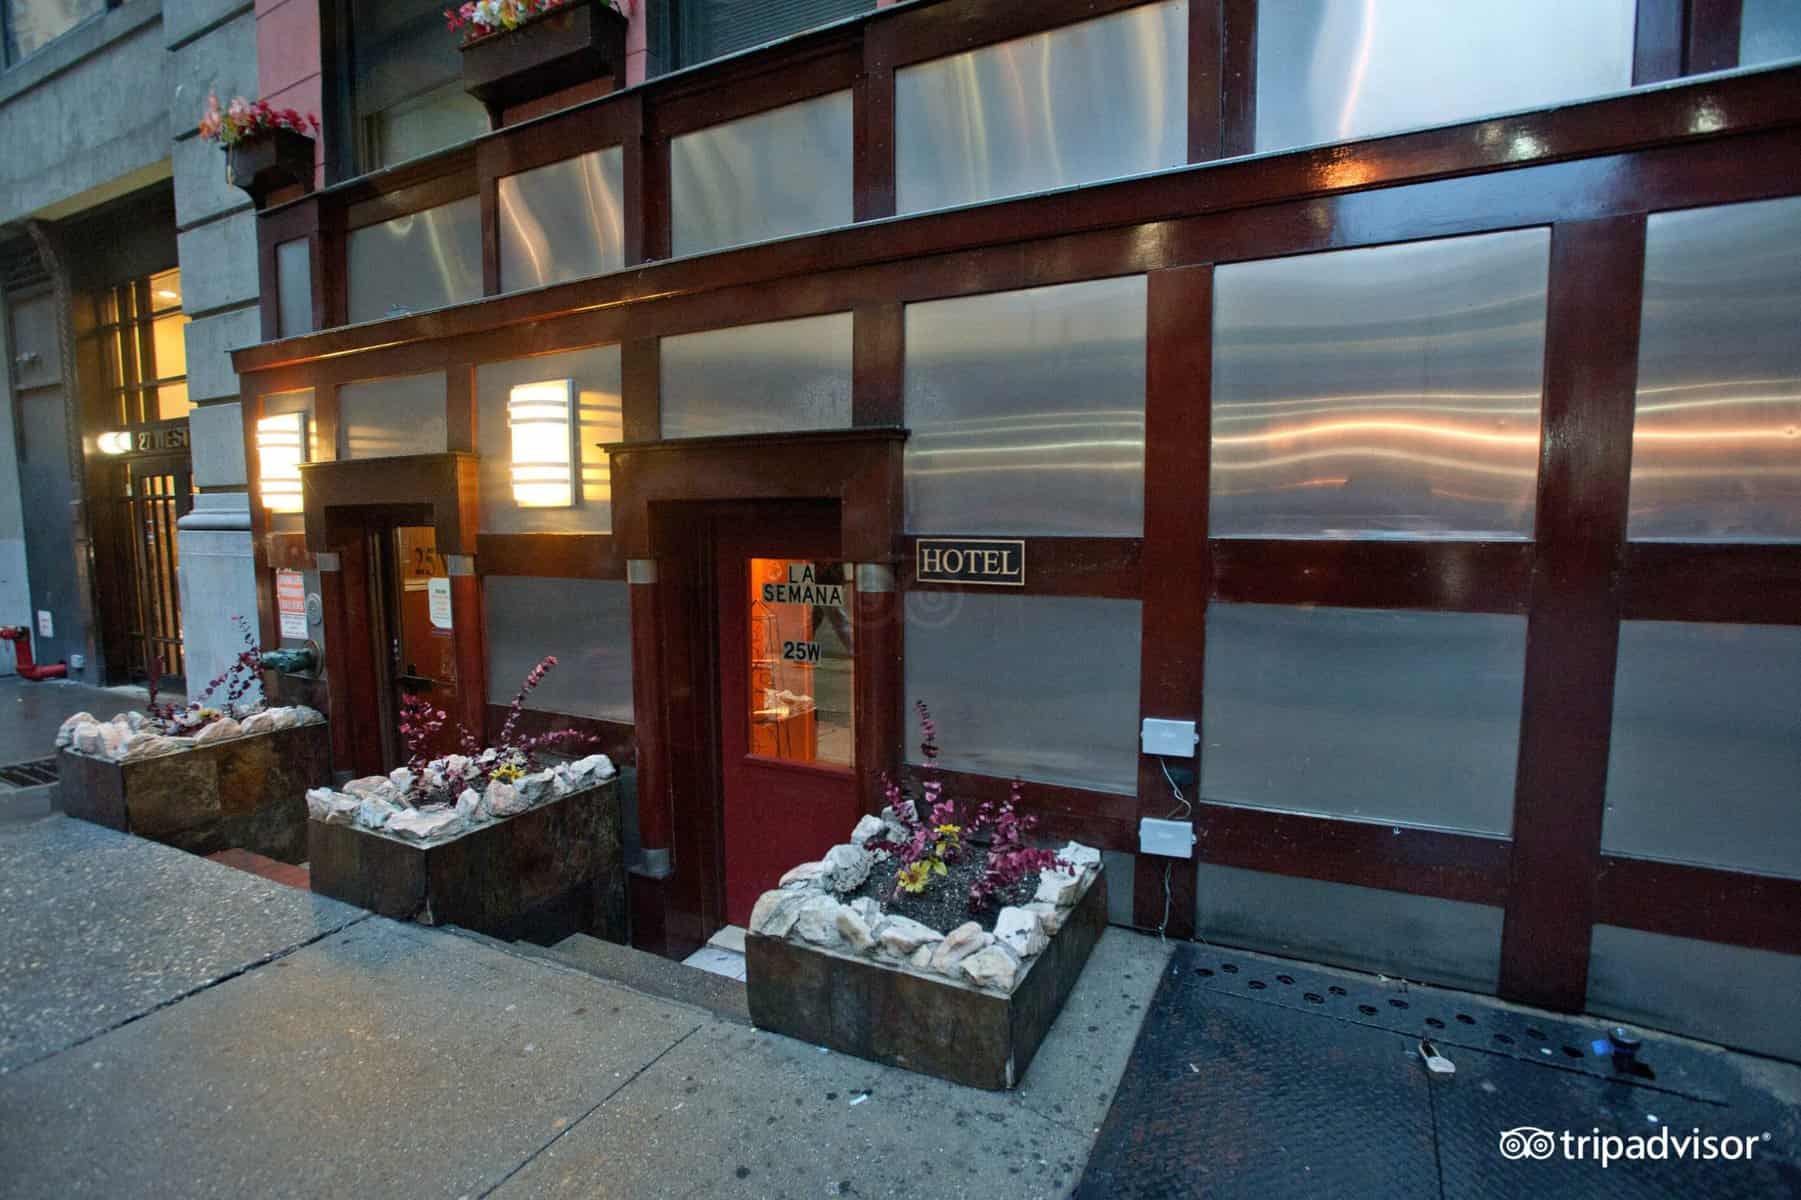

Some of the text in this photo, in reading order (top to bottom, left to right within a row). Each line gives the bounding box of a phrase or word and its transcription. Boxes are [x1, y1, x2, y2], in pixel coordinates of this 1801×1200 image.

[921, 548, 1020, 575] HOTEL
[789, 564, 814, 583] LA
[764, 584, 842, 604] SEMANA
[783, 641, 820, 661] 25W
